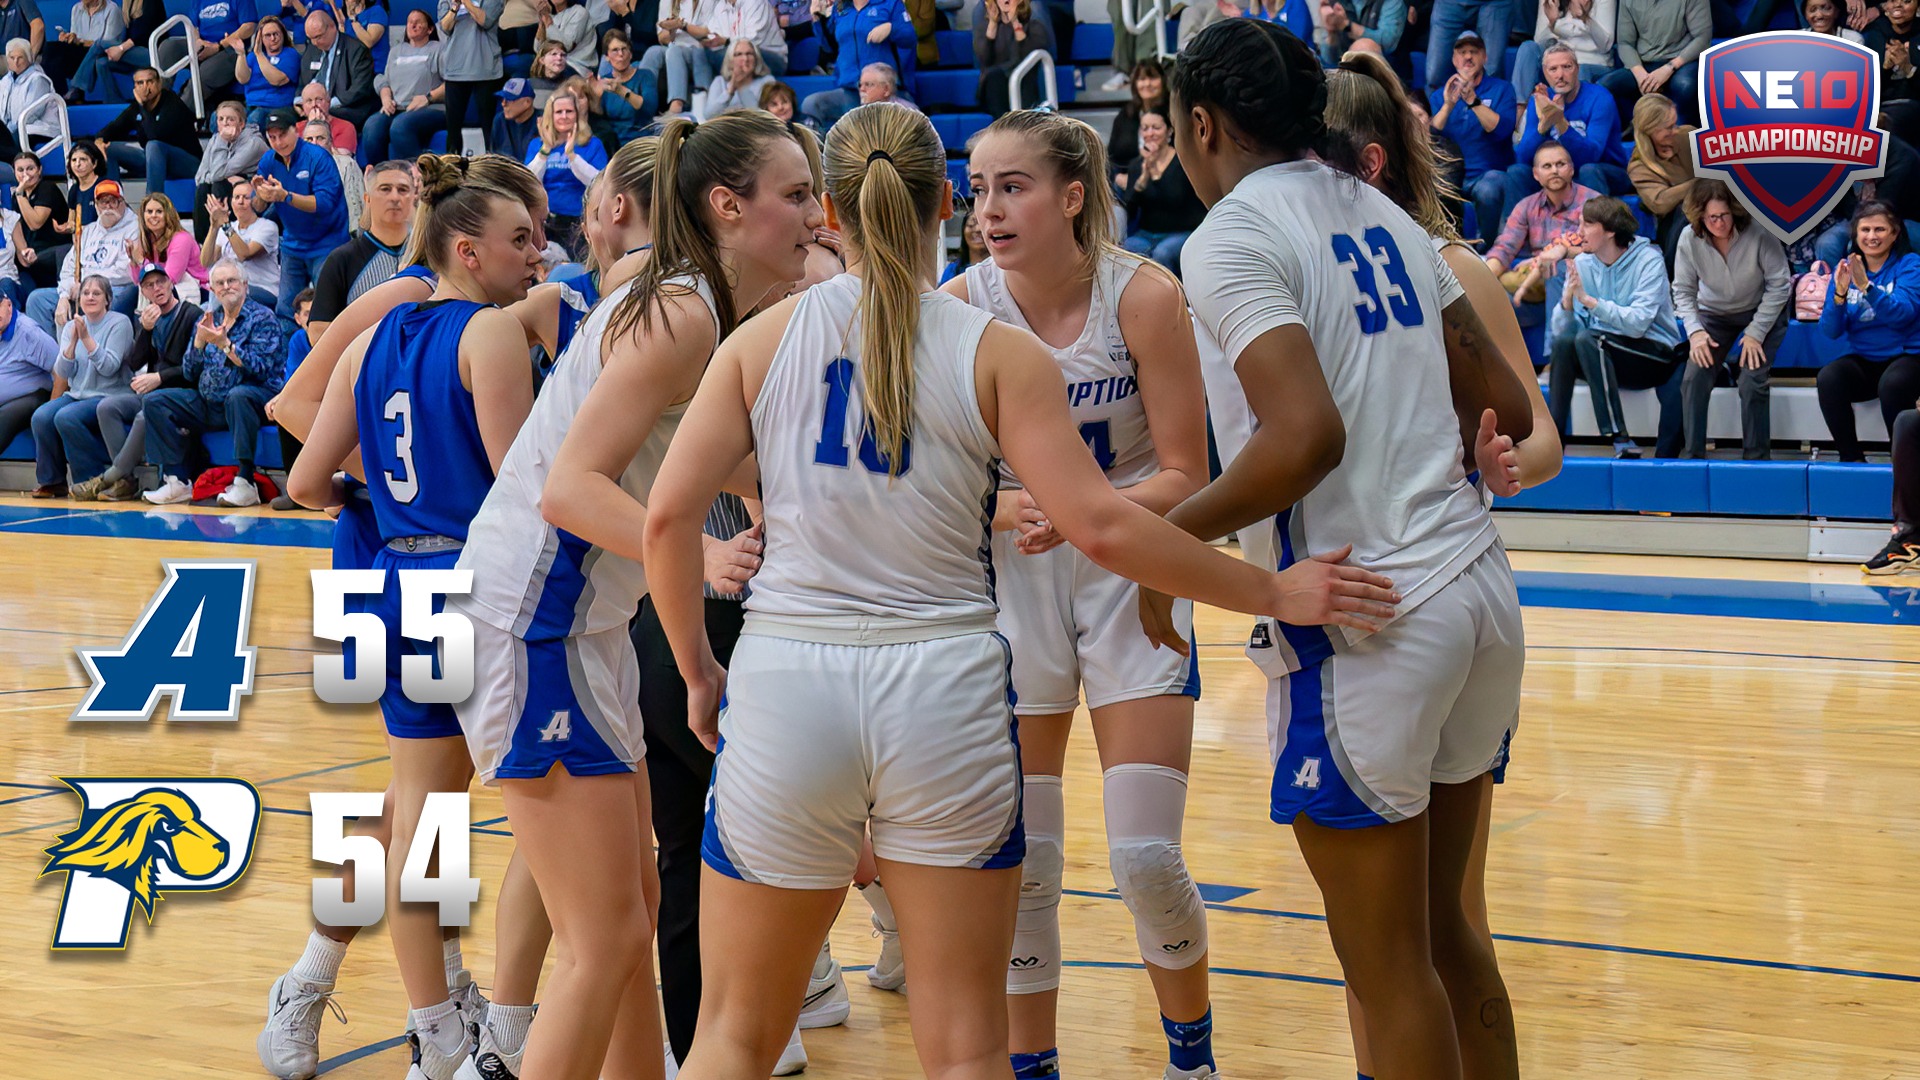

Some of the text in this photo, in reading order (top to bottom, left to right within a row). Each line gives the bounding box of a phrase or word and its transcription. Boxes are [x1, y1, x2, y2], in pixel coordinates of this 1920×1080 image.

[1330, 224, 1425, 336] 33
[384, 390, 420, 504] 3
[537, 709, 572, 743] A
[1290, 756, 1322, 790] A
